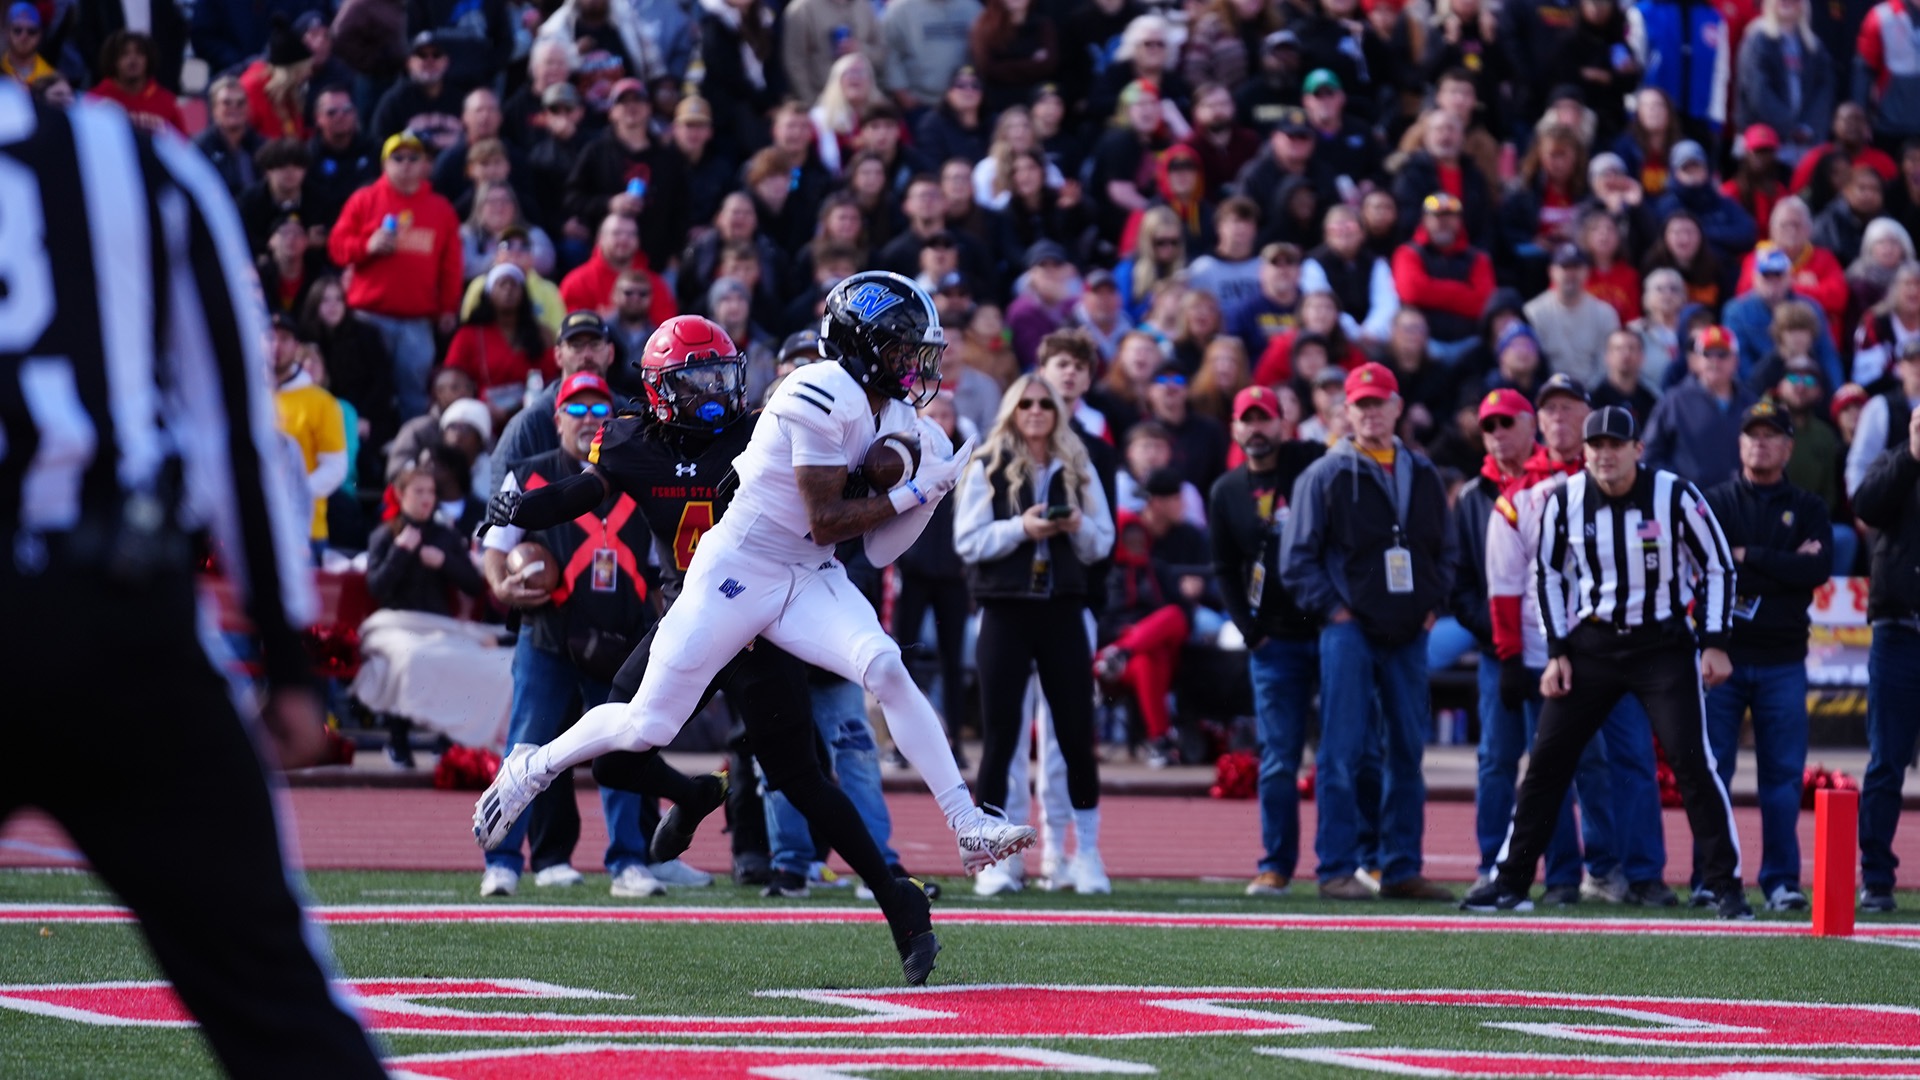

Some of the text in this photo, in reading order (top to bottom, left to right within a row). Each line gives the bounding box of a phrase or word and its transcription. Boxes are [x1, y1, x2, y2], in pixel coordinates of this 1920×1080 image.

[847, 281, 905, 322] GV
[651, 485, 687, 498] FERRIS
[673, 501, 714, 571] 4
[1645, 552, 1659, 570] S
[718, 577, 746, 599] GV
